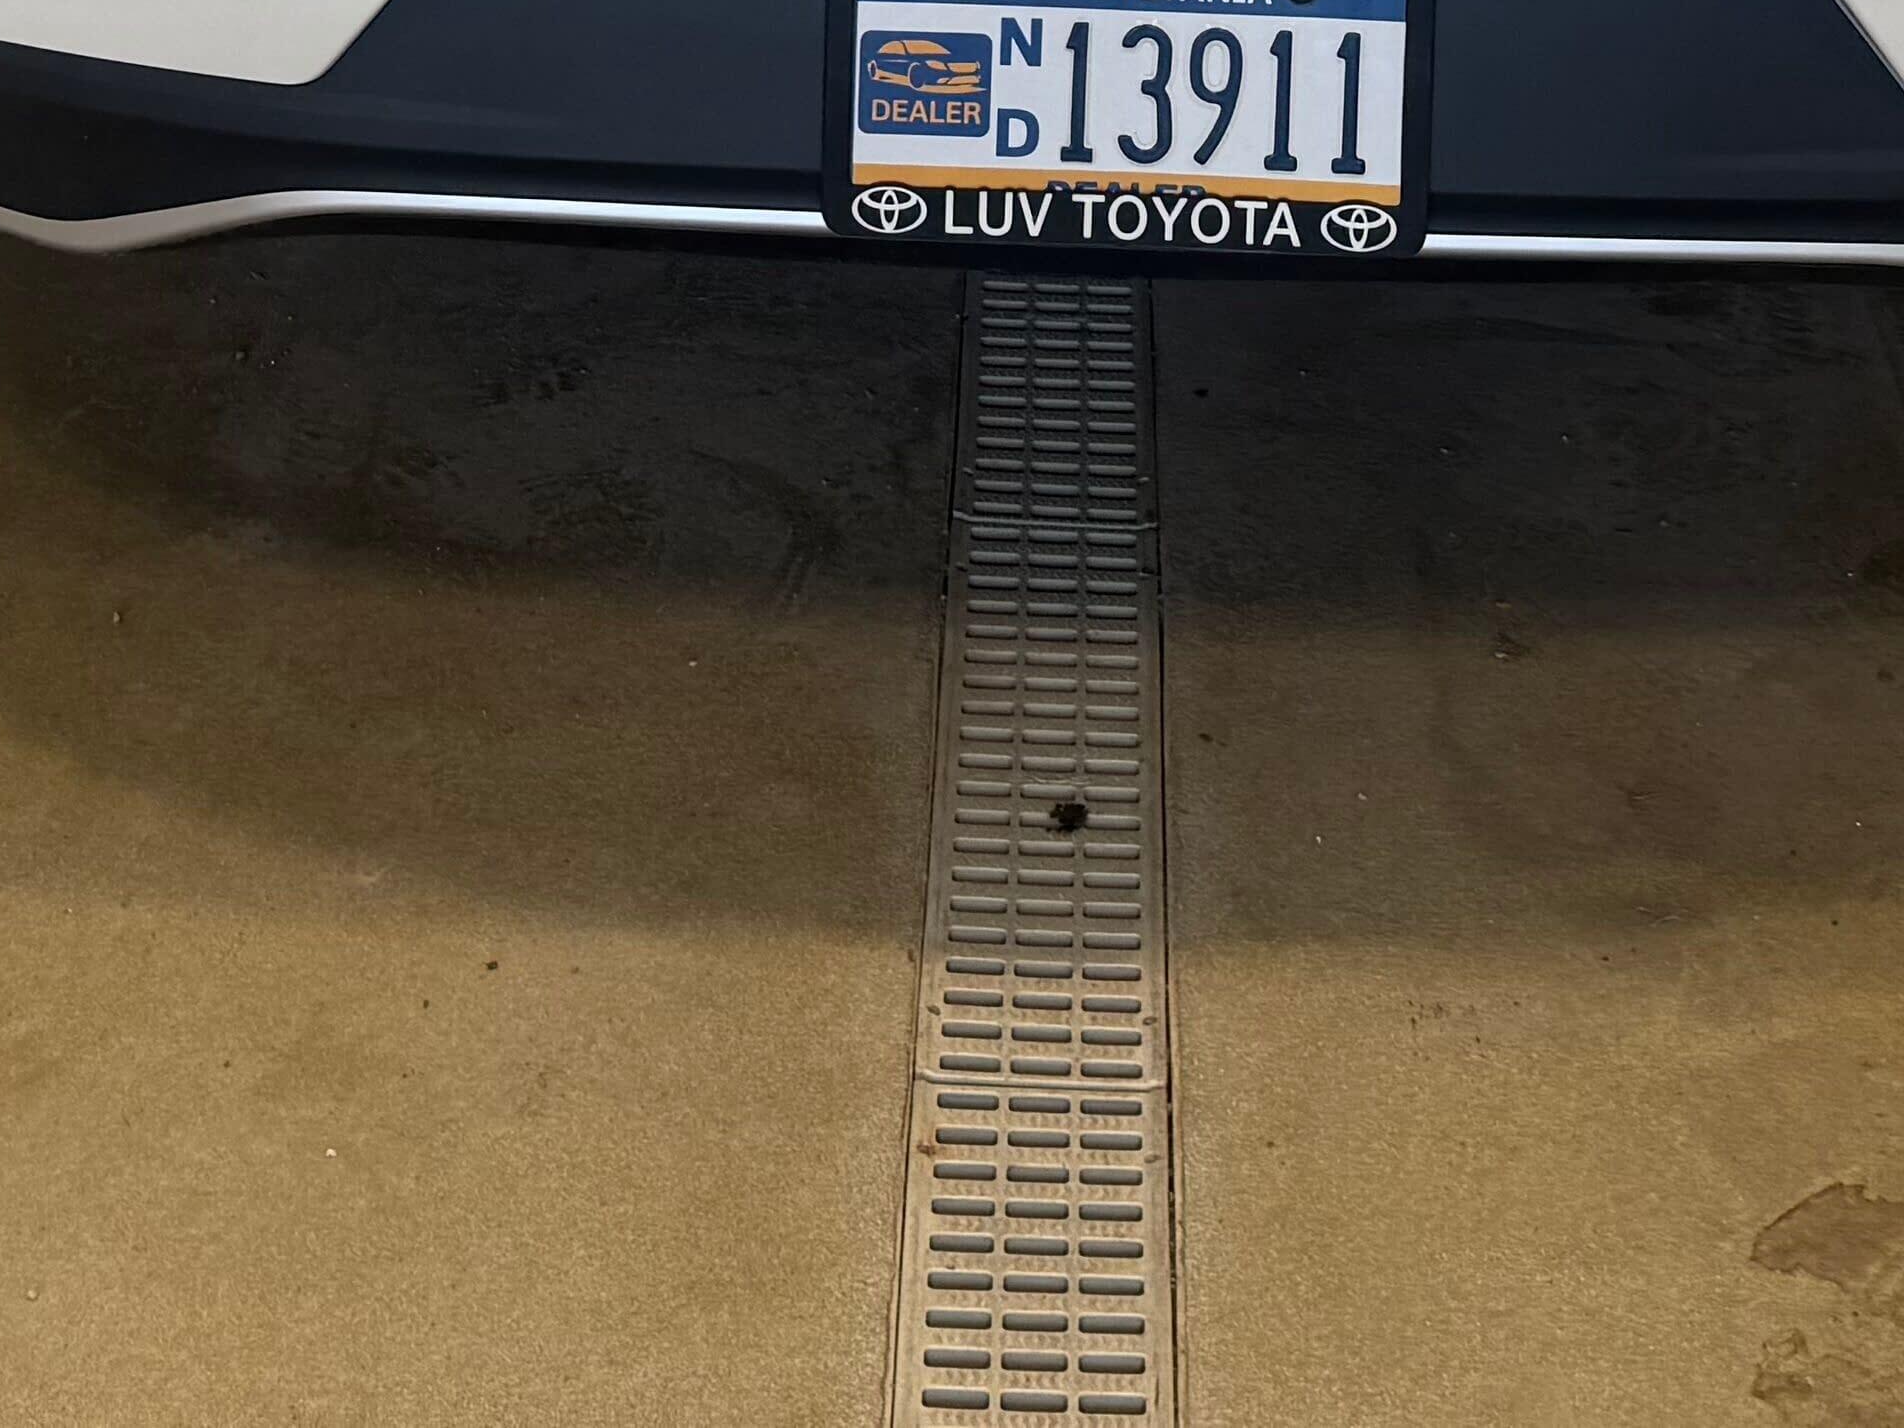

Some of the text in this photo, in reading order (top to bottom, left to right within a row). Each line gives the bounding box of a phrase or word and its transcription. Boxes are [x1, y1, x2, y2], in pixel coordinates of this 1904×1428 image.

[870, 98, 982, 126] DEALER
[1059, 21, 1367, 176] 13911
[943, 189, 1302, 248] LUV TOYOTA
